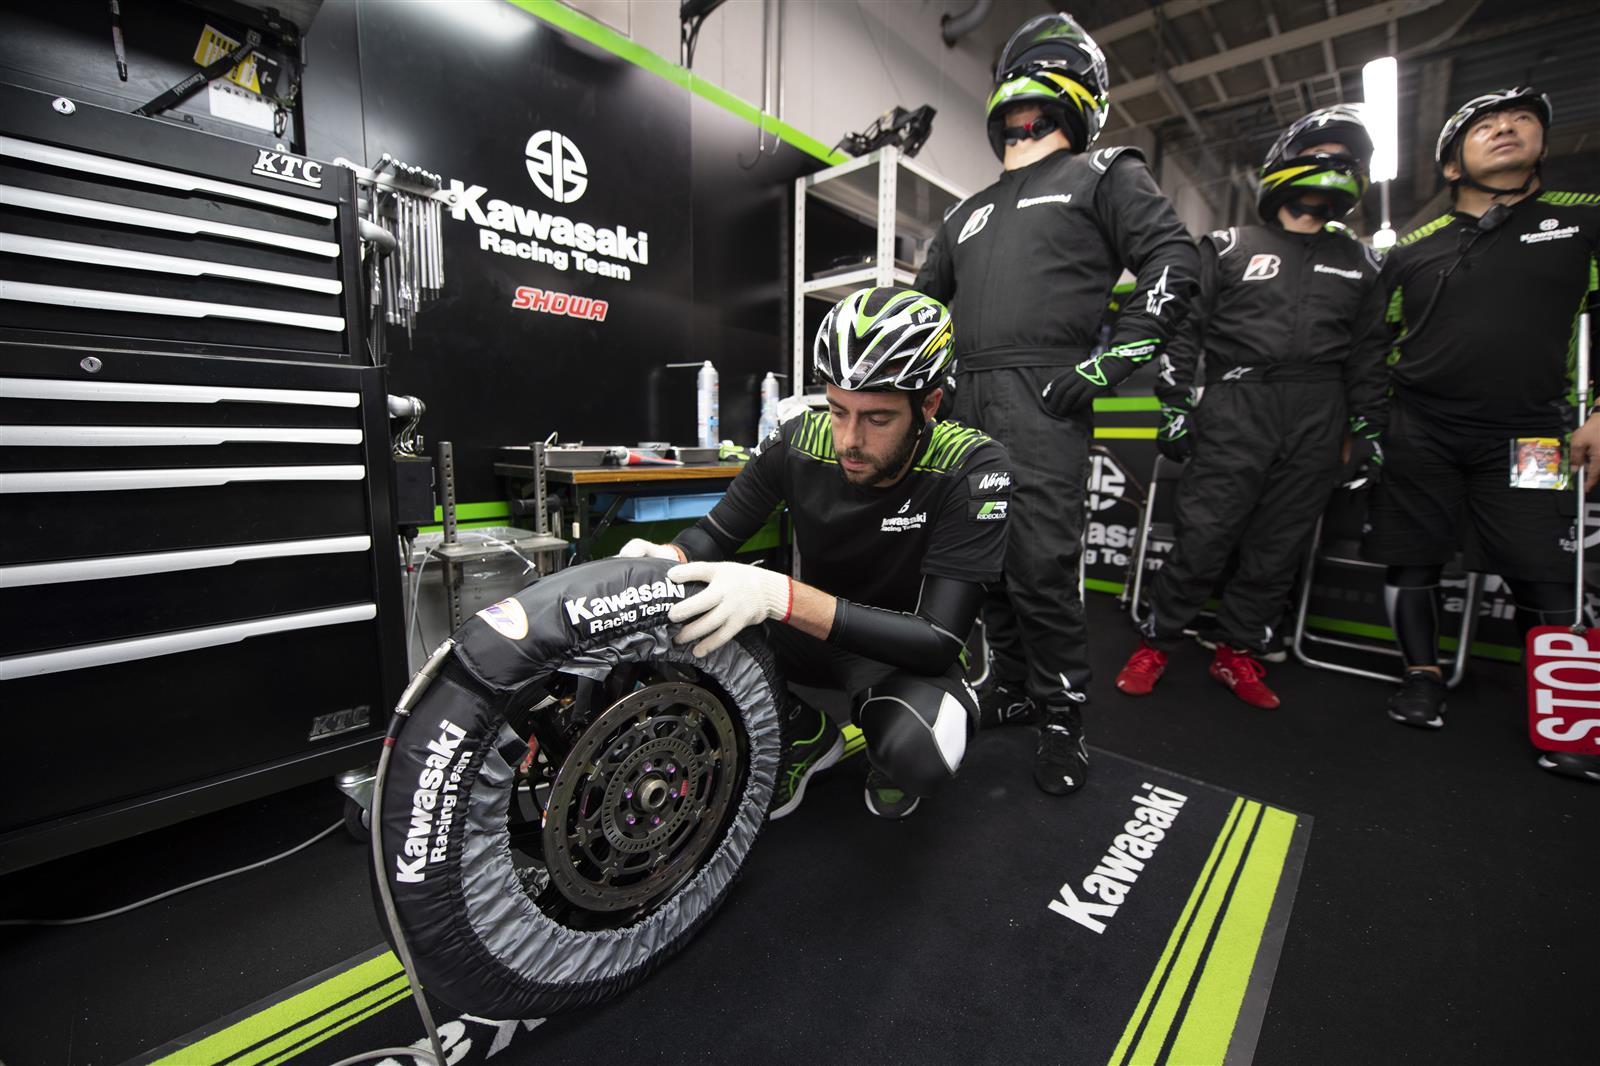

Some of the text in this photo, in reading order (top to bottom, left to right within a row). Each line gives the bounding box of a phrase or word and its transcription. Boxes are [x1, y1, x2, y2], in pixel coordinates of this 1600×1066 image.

[253, 149, 322, 183] KTC
[449, 178, 649, 265] Kawasaki
[479, 228, 632, 281] Racing Team
[512, 286, 609, 322] SHOWA
[978, 472, 1011, 492] Ninja
[589, 609, 637, 634] Racing
[1533, 632, 1600, 746] STOP
[310, 705, 370, 737] KTC
[396, 719, 468, 883] Kawasaki
[429, 751, 474, 864] Racing Team
[1047, 782, 1189, 935] Kawasaki
